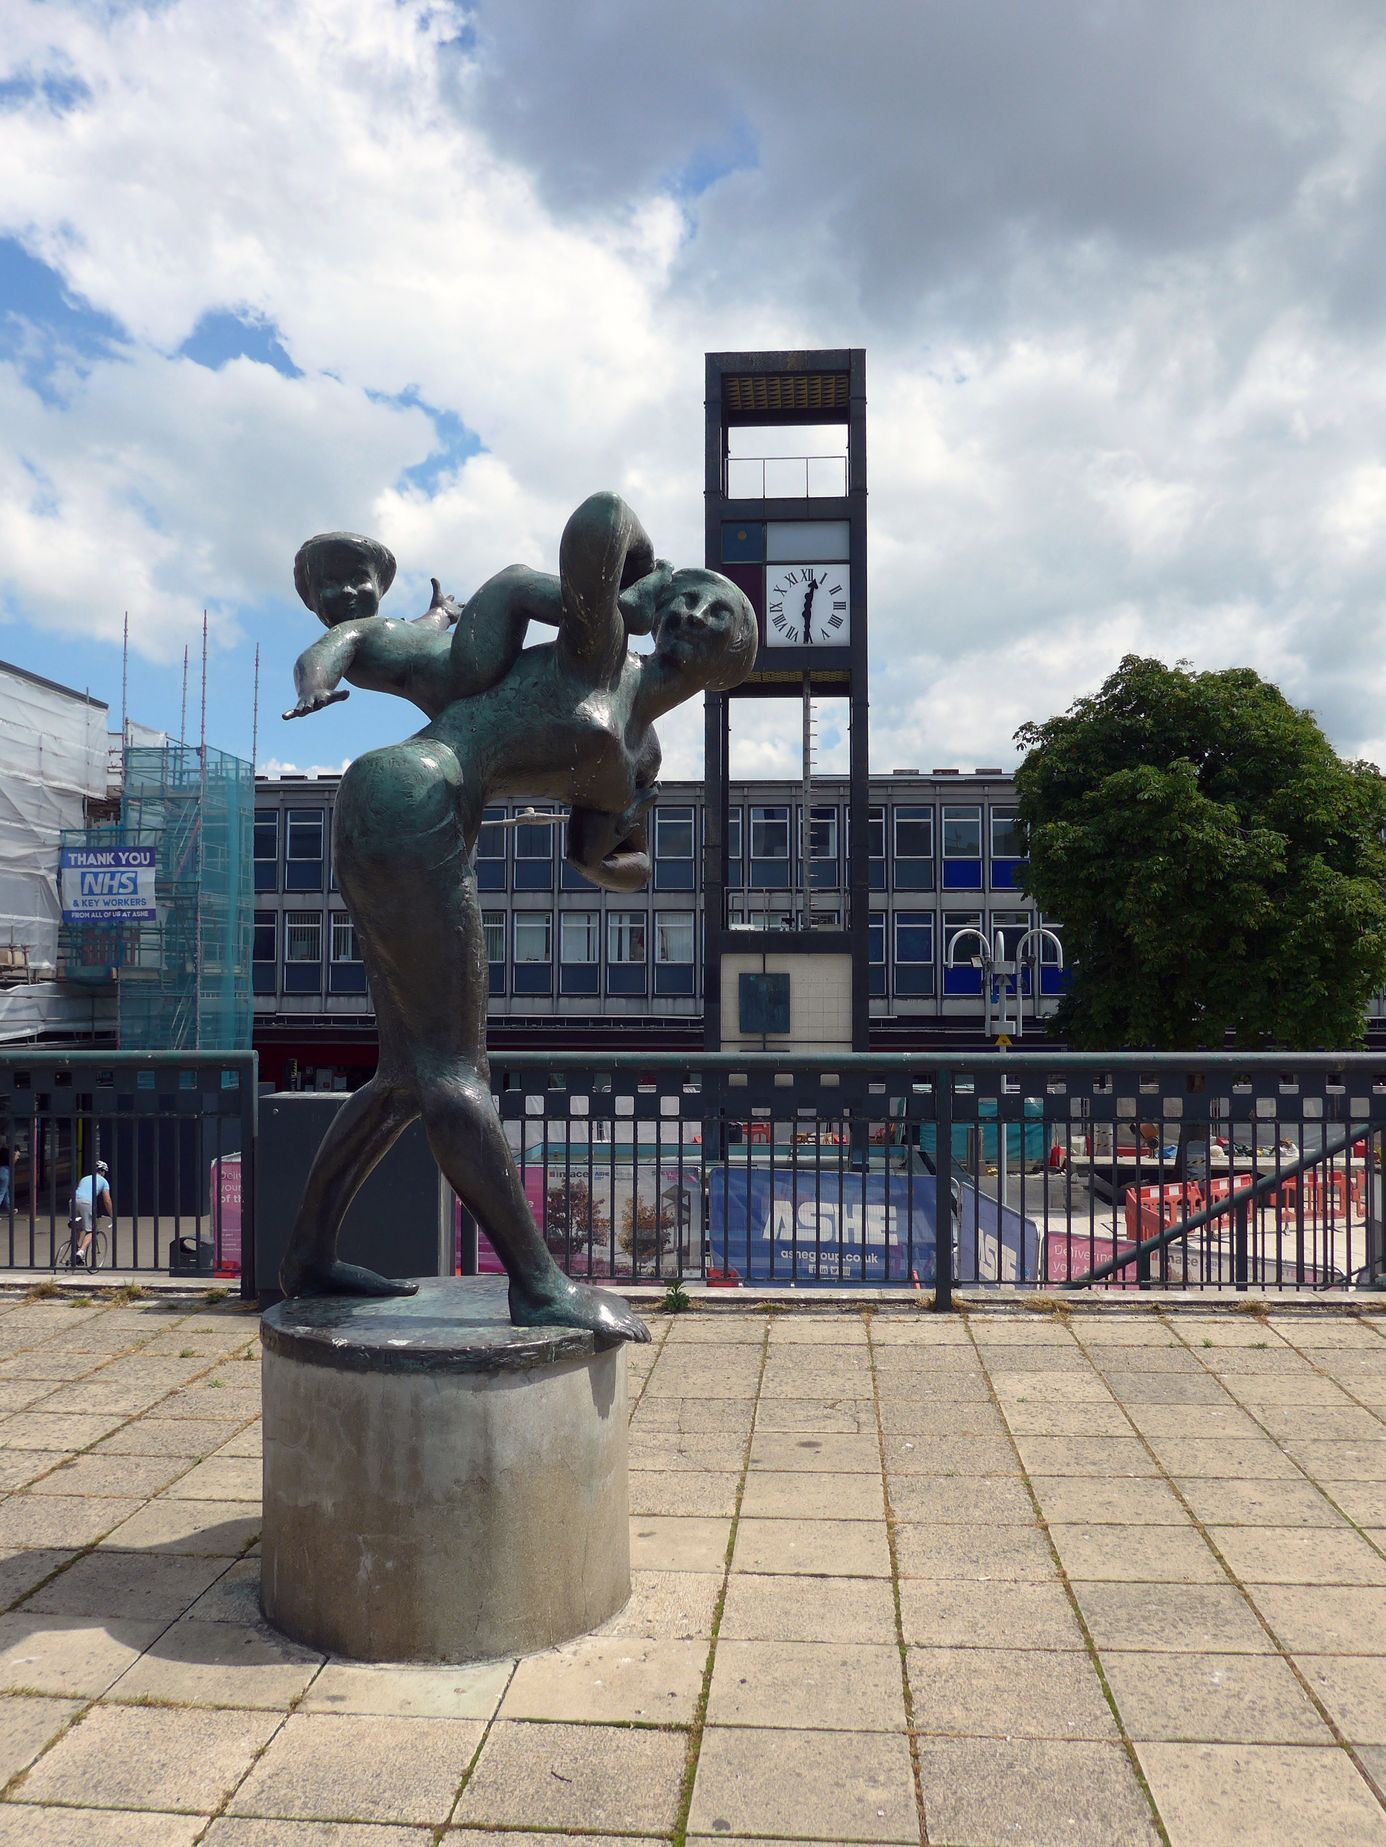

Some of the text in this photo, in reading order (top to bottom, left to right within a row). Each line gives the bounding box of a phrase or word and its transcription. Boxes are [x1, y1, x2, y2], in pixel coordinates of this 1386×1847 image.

[784, 572, 798, 588] XI
[800, 569, 813, 582] XII
[773, 585, 787, 597] X
[829, 584, 842, 596] II
[770, 601, 783, 613] IX
[833, 601, 847, 610] III
[772, 613, 788, 632] VIII
[828, 613, 844, 629] IIII
[785, 625, 799, 642] VII
[820, 627, 831, 640] V
[68, 852, 150, 866] THANK YOU
[82, 872, 136, 895] NHS
[72, 898, 147, 907] & KEY WORKERS
[762, 1200, 899, 1246] ASHE
[781, 1250, 879, 1264] ashegoup.couk
[1055, 1244, 1113, 1263] Delivein
